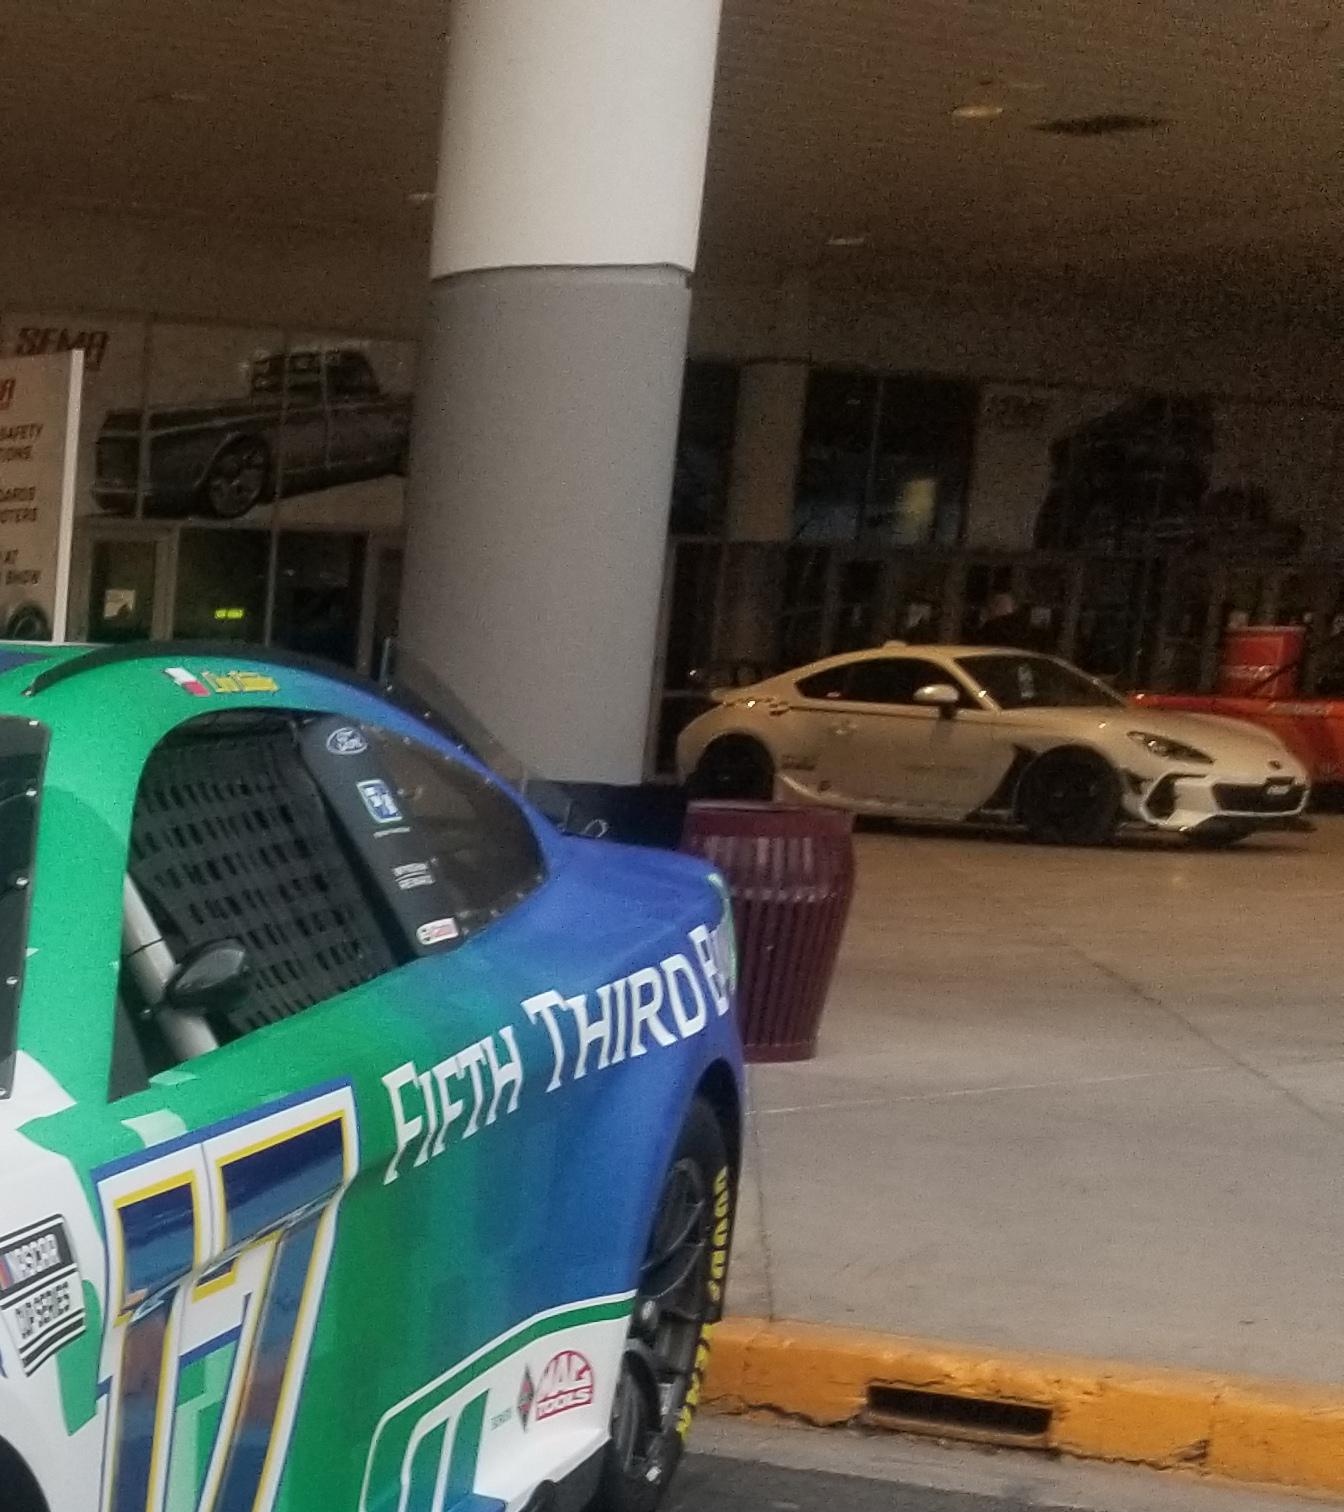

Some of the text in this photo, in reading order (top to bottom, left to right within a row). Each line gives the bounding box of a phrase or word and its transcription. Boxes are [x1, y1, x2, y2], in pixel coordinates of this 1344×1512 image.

[0, 423, 44, 442] SAFETY
[381, 1025, 524, 1185] FIFTH
[521, 953, 708, 1093] THIRD
